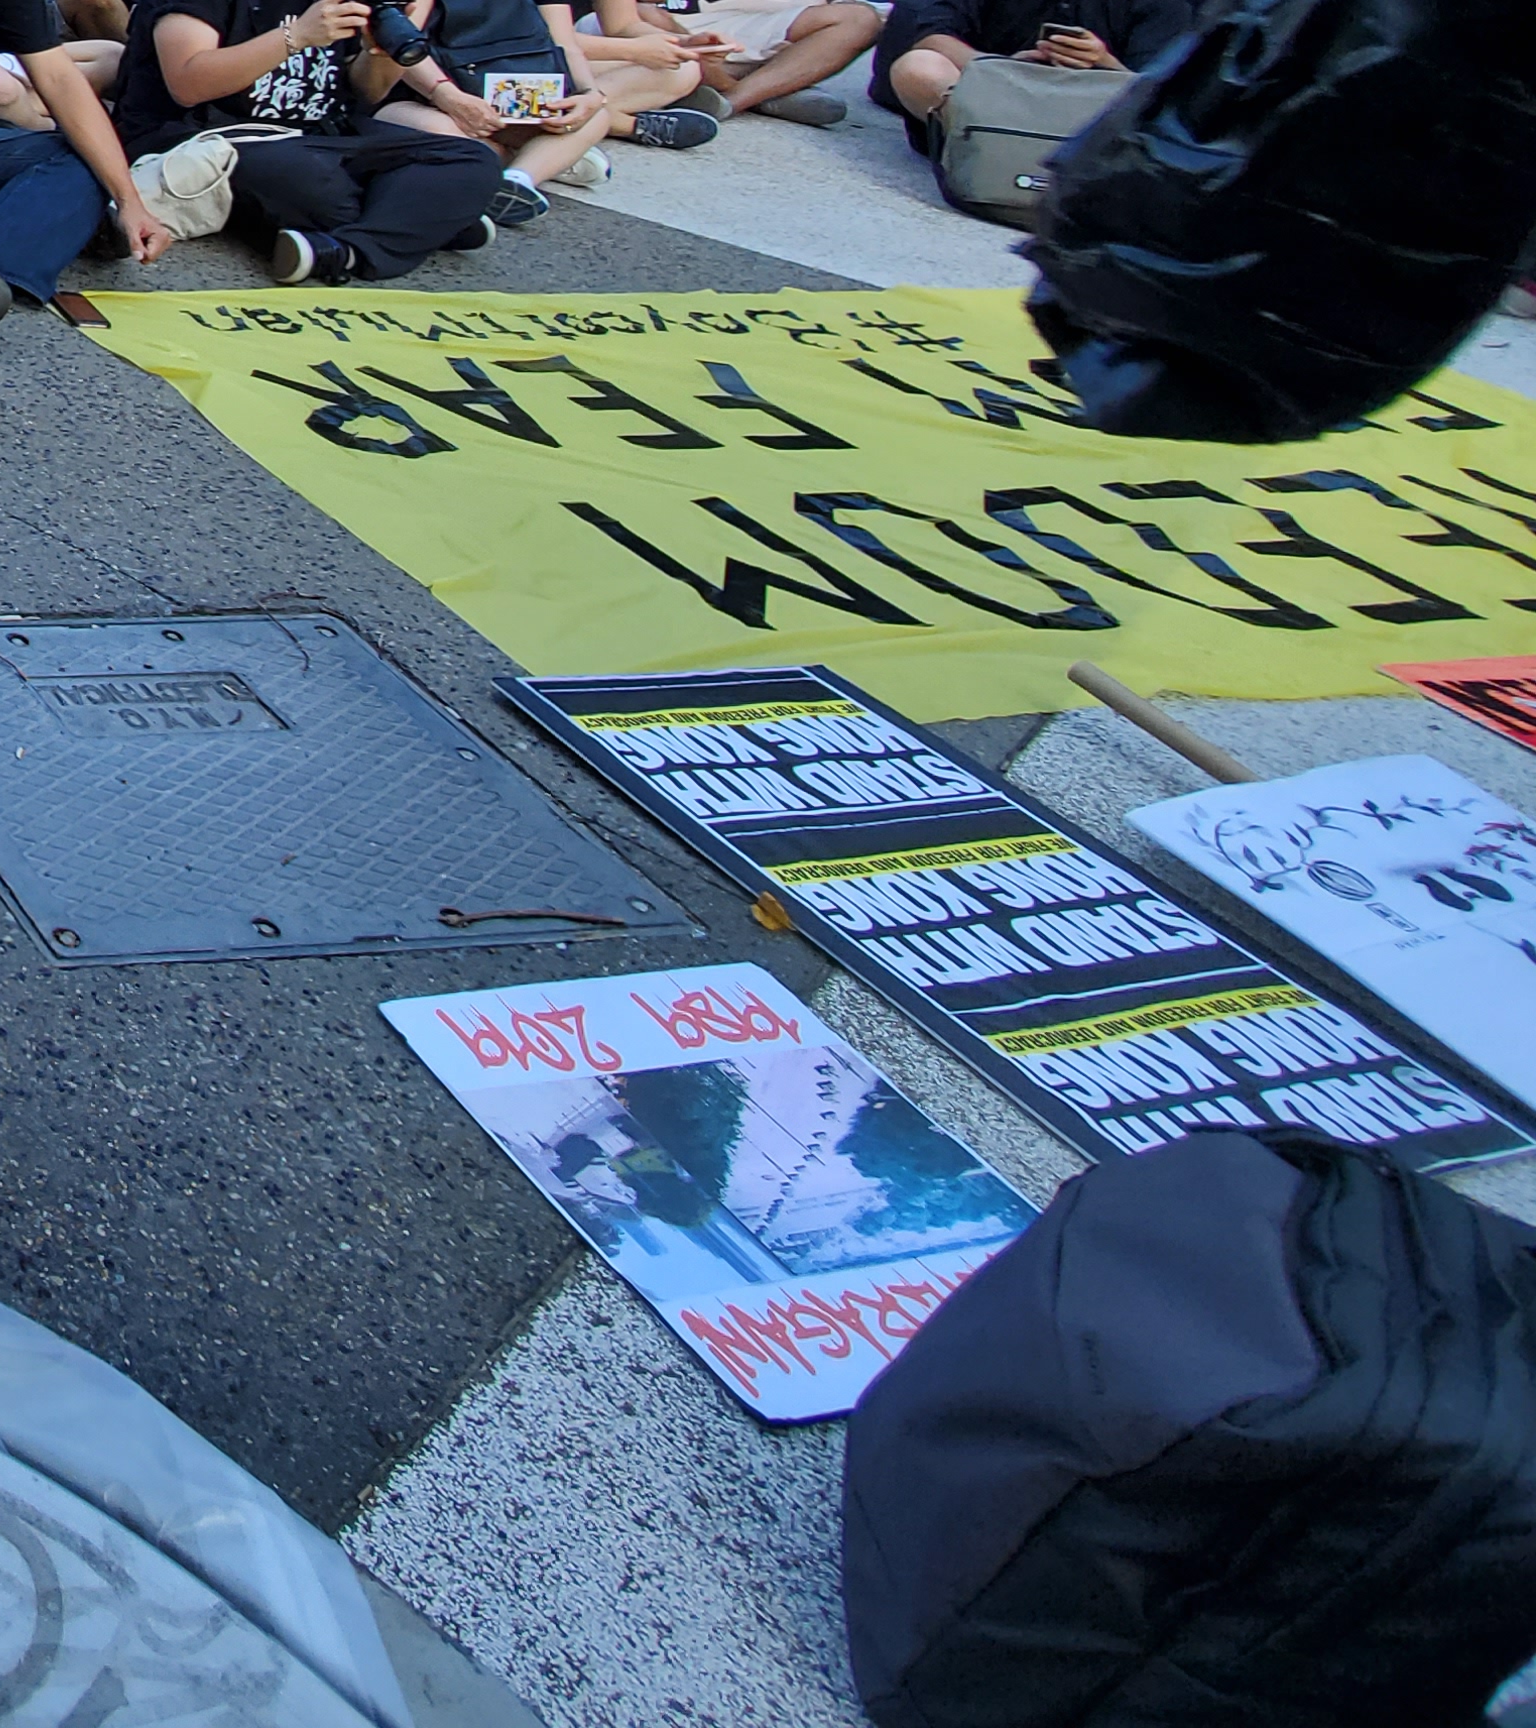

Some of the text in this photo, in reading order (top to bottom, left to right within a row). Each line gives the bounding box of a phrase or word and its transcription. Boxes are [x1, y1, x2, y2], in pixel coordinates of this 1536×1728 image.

[250, 354, 861, 460] FEAR
[670, 711, 702, 724] AND
[704, 707, 769, 723] FREEDOM
[770, 704, 798, 716] FOR
[579, 712, 670, 731] DEMOCRACY
[592, 712, 928, 772] HONG KONG
[649, 754, 988, 817] STAND WITH
[977, 844, 1010, 861] FOR
[1009, 839, 1050, 856] FIGHT
[869, 857, 905, 872] AND
[904, 850, 978, 870] FREEDOM
[774, 862, 870, 883] DEMOCRACY
[790, 852, 1146, 933] HONG KONG
[856, 896, 1220, 990] STAND WITH
[1208, 997, 1245, 1015] FOR
[1242, 992, 1290, 1010] FIGHT
[436, 982, 802, 1072] 1989 2019
[1131, 1004, 1212, 1030] FREEDOM
[1097, 1019, 1136, 1037] AND
[996, 1027, 1101, 1053] DEMOCRACY
[1025, 999, 1404, 1110] HONG KONG
[1259, 1065, 1488, 1145] STAND
